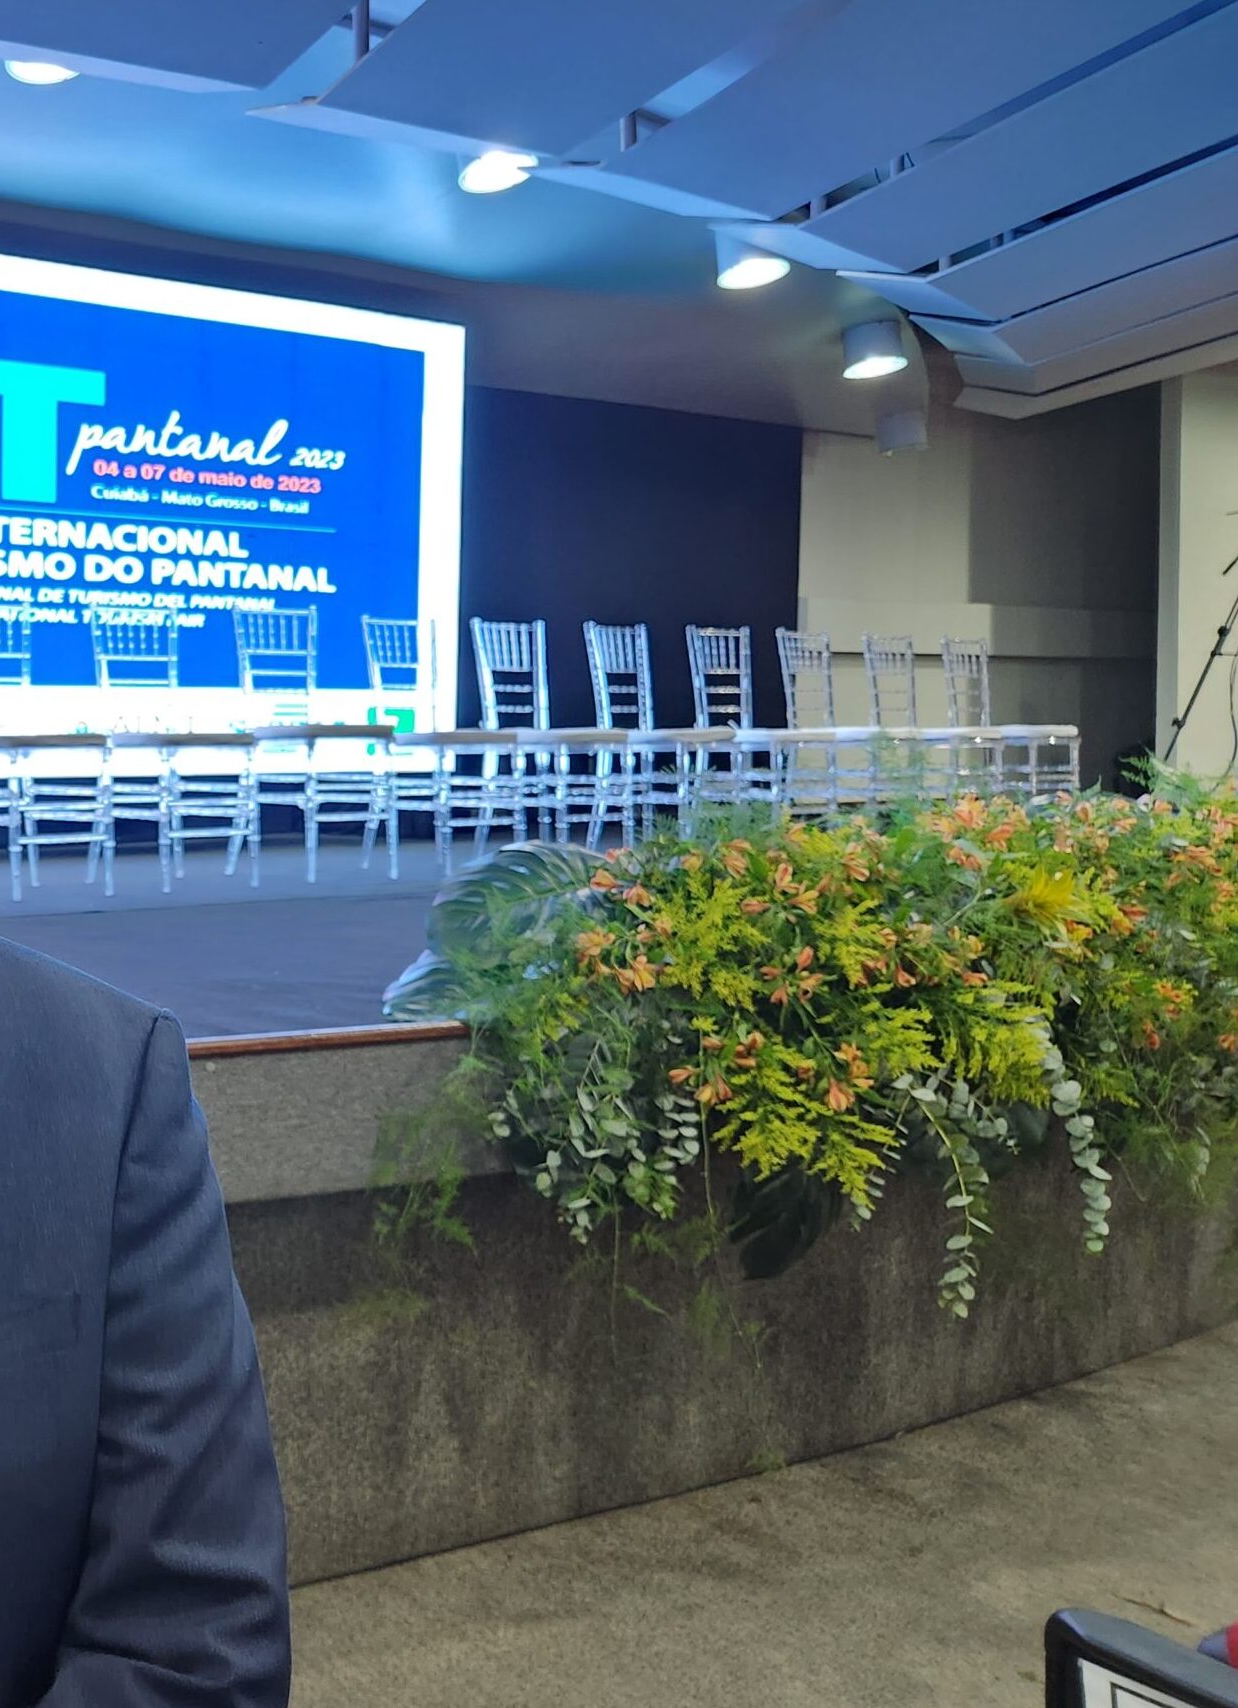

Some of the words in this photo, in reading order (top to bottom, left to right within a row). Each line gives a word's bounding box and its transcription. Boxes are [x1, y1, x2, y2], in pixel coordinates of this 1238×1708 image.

[65, 410, 289, 476] pantanal
[289, 447, 347, 471] 2023
[93, 459, 120, 477] 04
[123, 465, 137, 478] a
[141, 463, 167, 481] 07
[169, 466, 195, 484] de
[198, 470, 247, 488] maio
[250, 473, 274, 490] de
[278, 475, 322, 494] 2023
[90, 482, 150, 502] Cuiabá
[161, 489, 203, 508] Mato
[205, 492, 259, 511] Grosso
[269, 498, 310, 514] Brasil
[83, 553, 144, 584] DO
[151, 557, 338, 593] PANTANAL
[37, 587, 66, 604] DE
[68, 588, 153, 608] TURISMO
[153, 592, 187, 609] DEL
